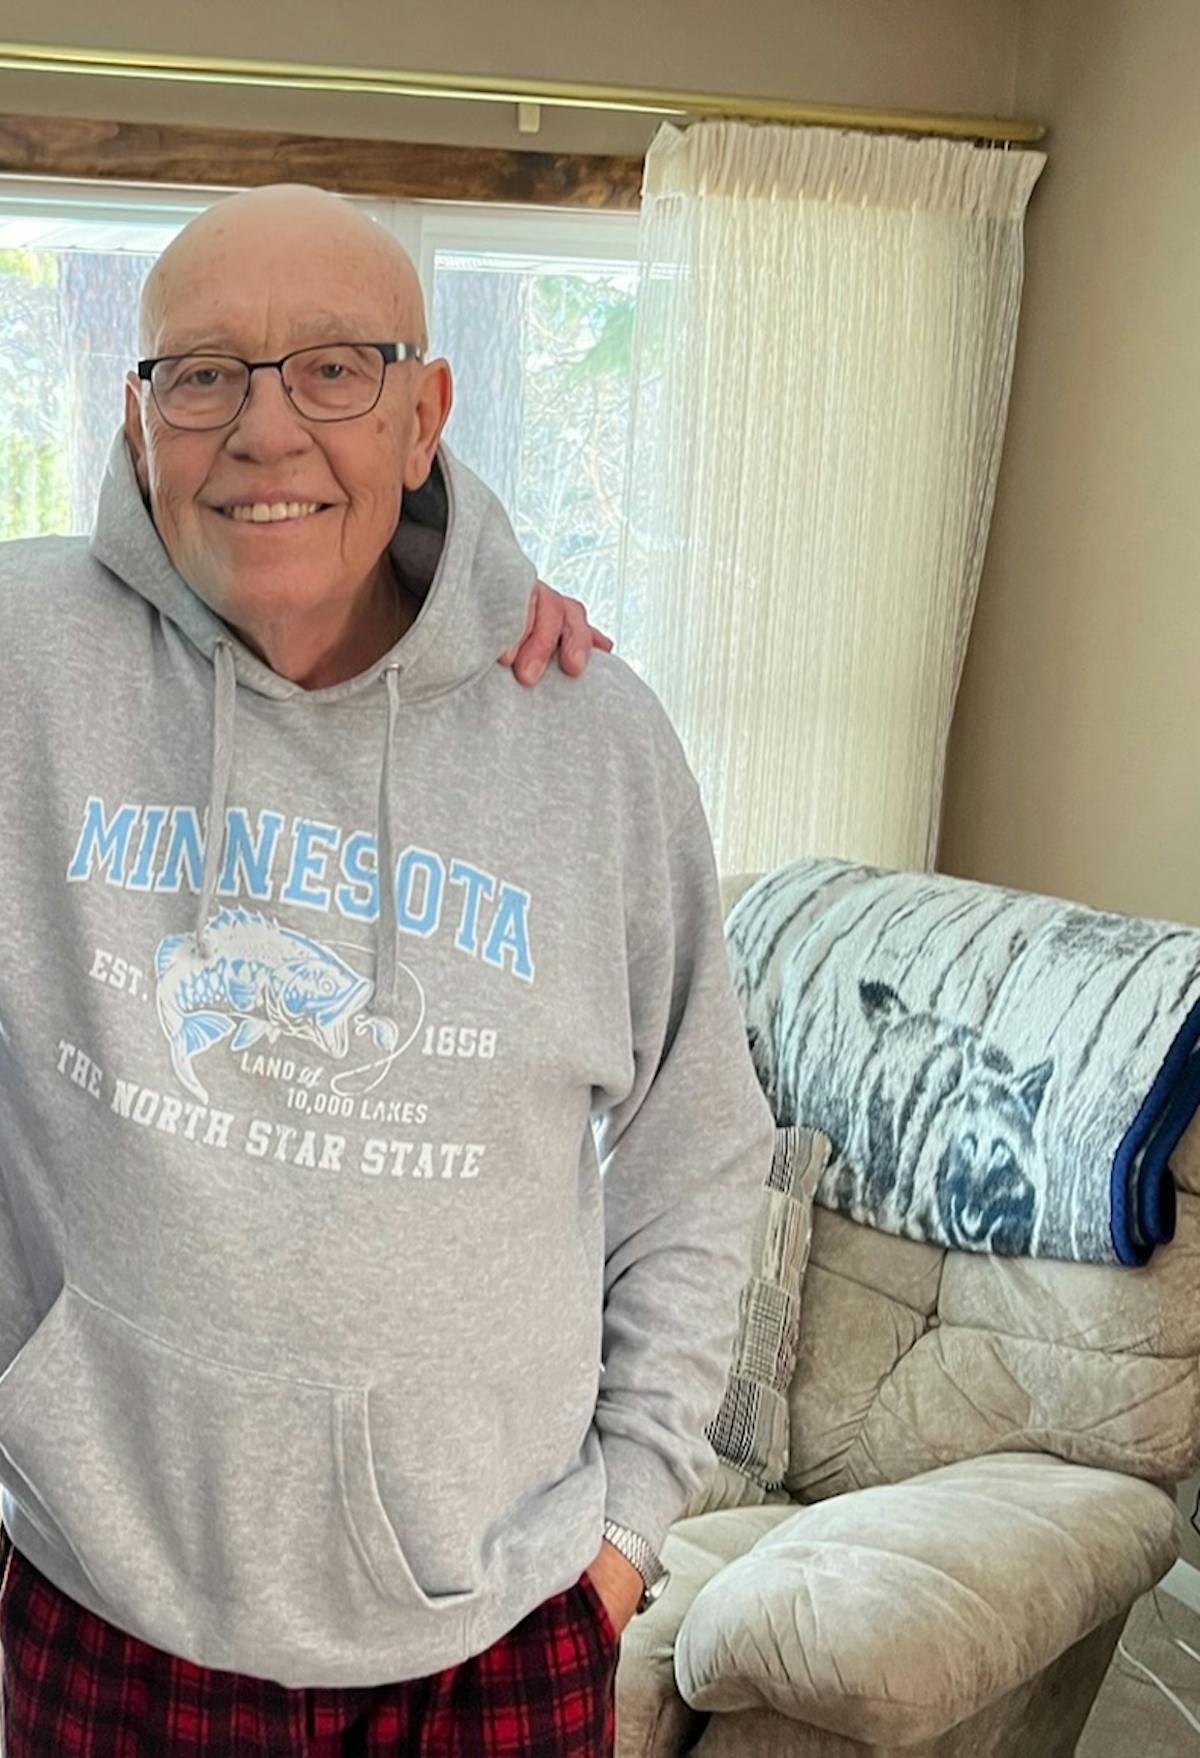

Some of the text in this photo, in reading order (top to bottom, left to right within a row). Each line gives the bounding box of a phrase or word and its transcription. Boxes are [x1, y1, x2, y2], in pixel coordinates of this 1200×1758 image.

[66, 796, 535, 984] MINNESOTA
[89, 948, 148, 1001] EST.
[241, 1051, 325, 1087] LAND of
[57, 1039, 486, 1179] THE NORTH STAR STATE
[287, 1087, 429, 1124] 10,000 LAKES
